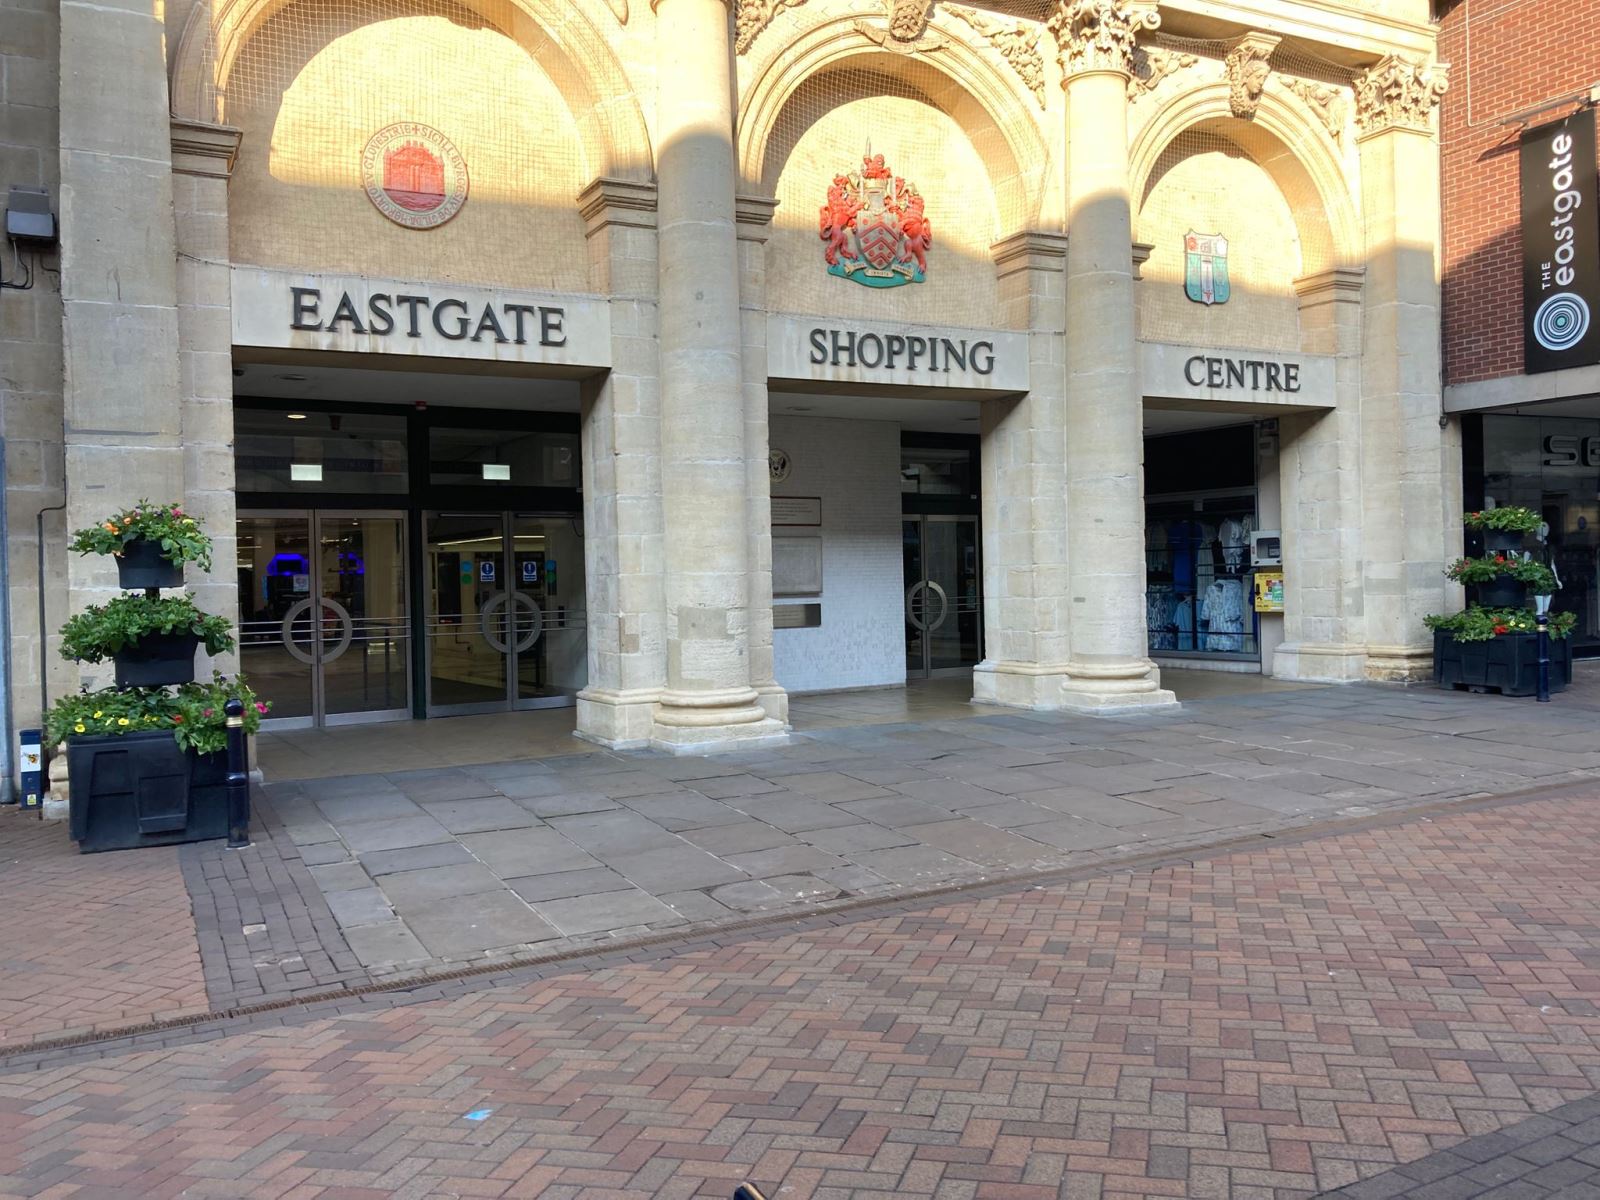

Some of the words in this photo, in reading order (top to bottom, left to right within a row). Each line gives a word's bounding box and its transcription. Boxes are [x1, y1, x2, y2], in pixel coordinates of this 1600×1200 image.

[1548, 134, 1582, 286] eastgate
[1541, 261, 1551, 290] THE
[290, 286, 567, 347] EASTGATE
[809, 328, 996, 375] SHOPPING
[1184, 354, 1301, 393] CENTRE
